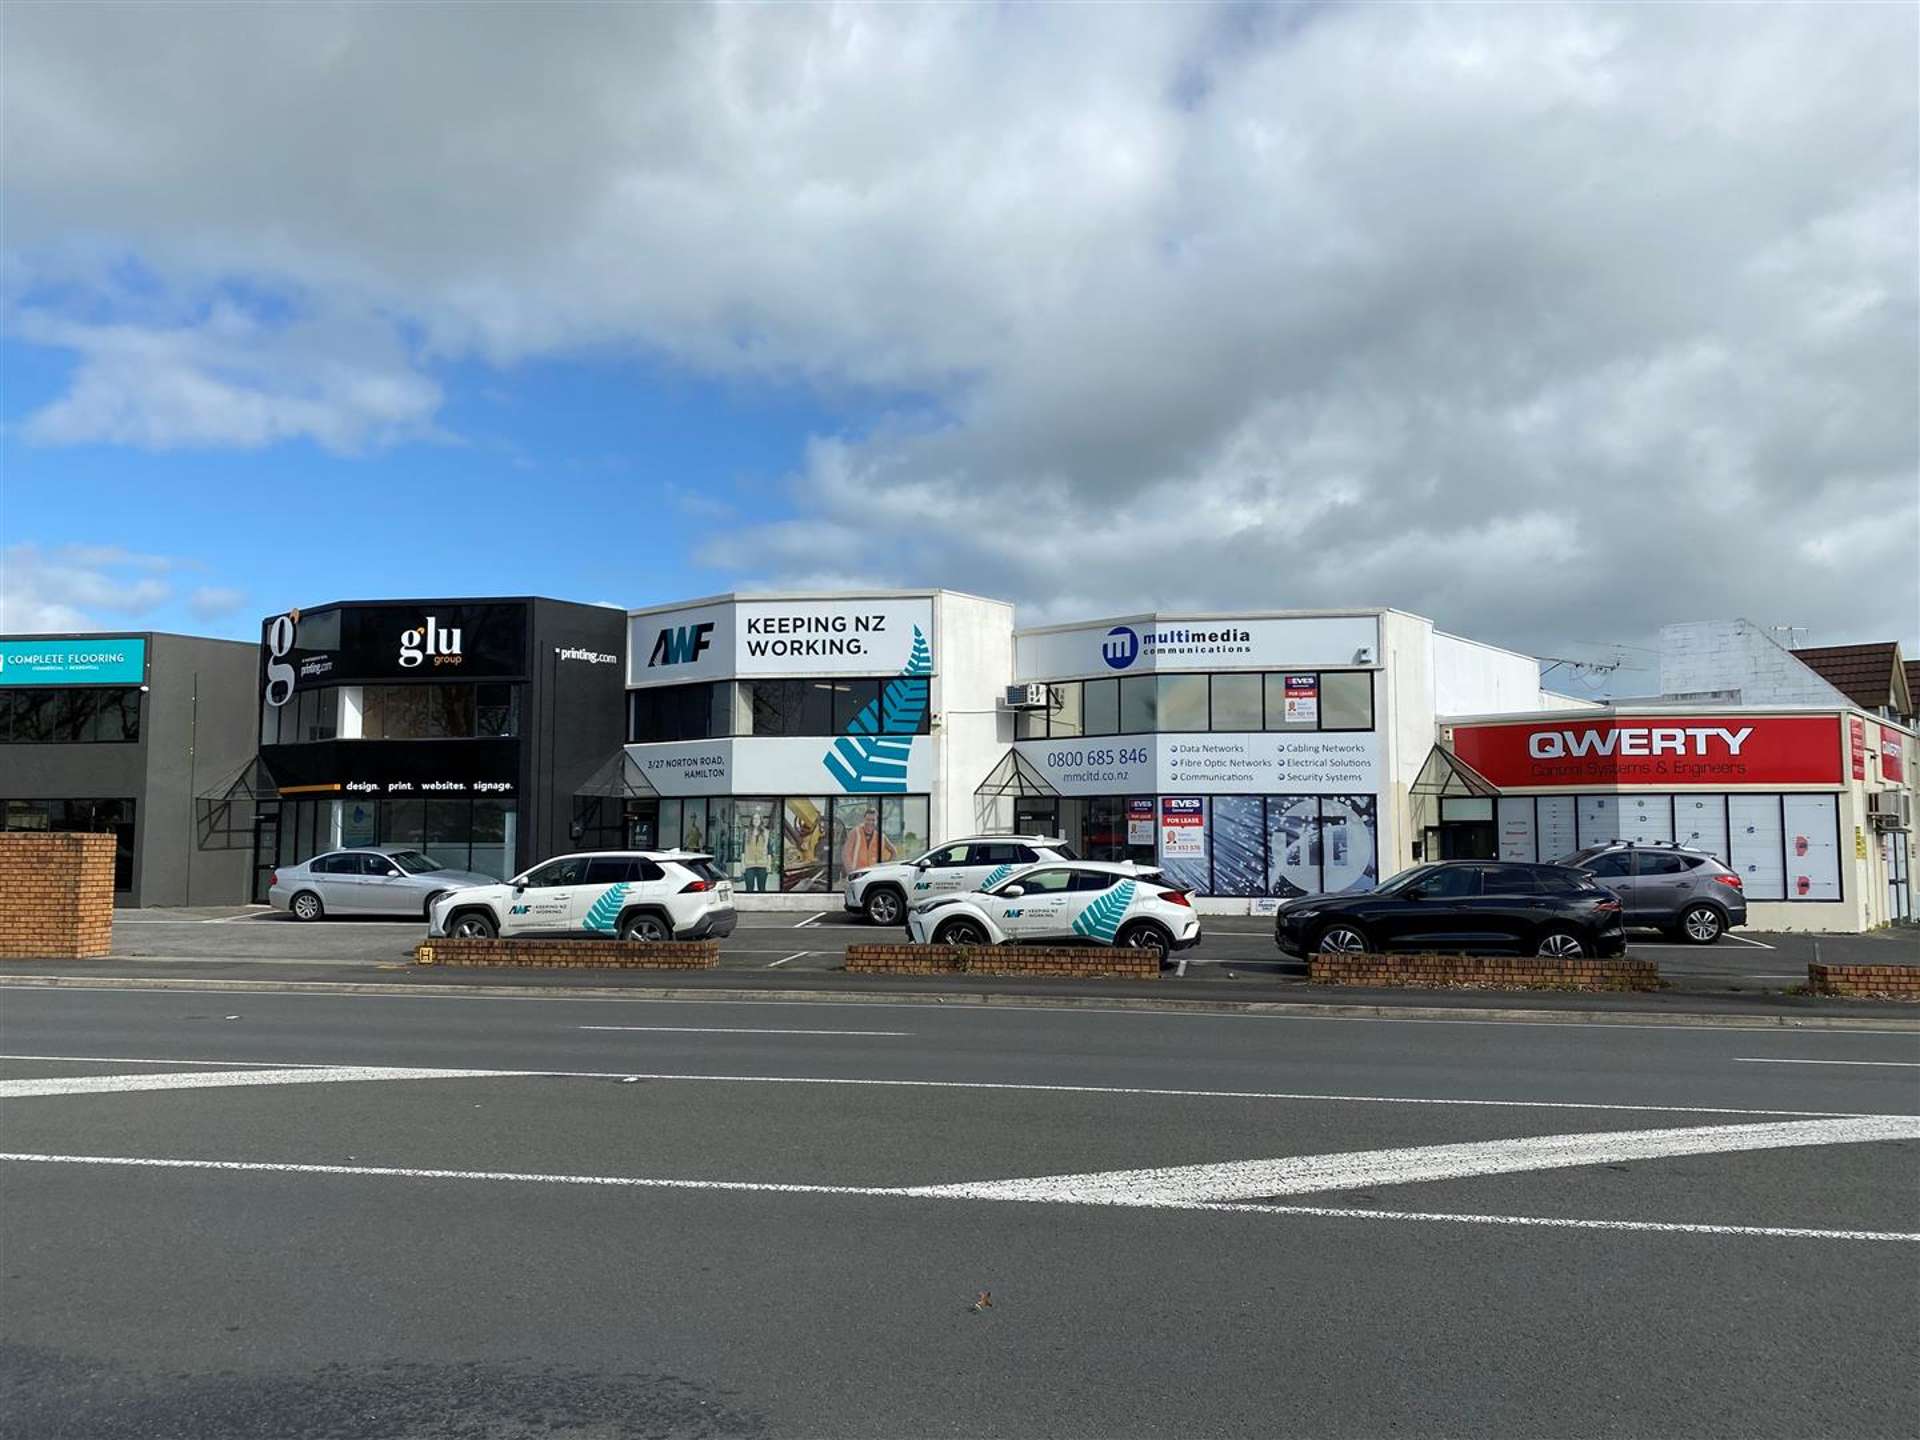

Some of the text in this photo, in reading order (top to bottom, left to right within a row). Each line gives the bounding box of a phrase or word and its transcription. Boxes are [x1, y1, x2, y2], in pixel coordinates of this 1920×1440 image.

[747, 615, 885, 634] KEEPING NZ
[398, 616, 462, 667] glu
[1143, 629, 1250, 644] multimedia
[647, 622, 715, 667] AWF
[747, 639, 868, 656] WORKING.
[1143, 645, 1251, 655] communications
[7, 653, 124, 664] COMPLETE FLOORING
[434, 655, 462, 665] group
[560, 649, 617, 664] printing.com
[1180, 744, 1244, 753] Data Networks
[1286, 744, 1365, 754] Cabling Networks
[1528, 728, 1753, 759] QWERTY
[666, 757, 698, 768] NORTON
[1047, 748, 1148, 767] 0800 685 846
[1287, 759, 1371, 767] Electrical Solutions
[1180, 759, 1272, 769] Fibre Optic Networks
[1588, 761, 1649, 777] Systems
[1656, 761, 1668, 774] &
[1674, 760, 1747, 777] Engineers
[684, 769, 725, 779] HAMILTON
[1180, 773, 1254, 781] Communications
[1287, 773, 1362, 783] Security Systems
[346, 781, 514, 792] design. print. websites. signage.
[1171, 799, 1200, 808] EVES
